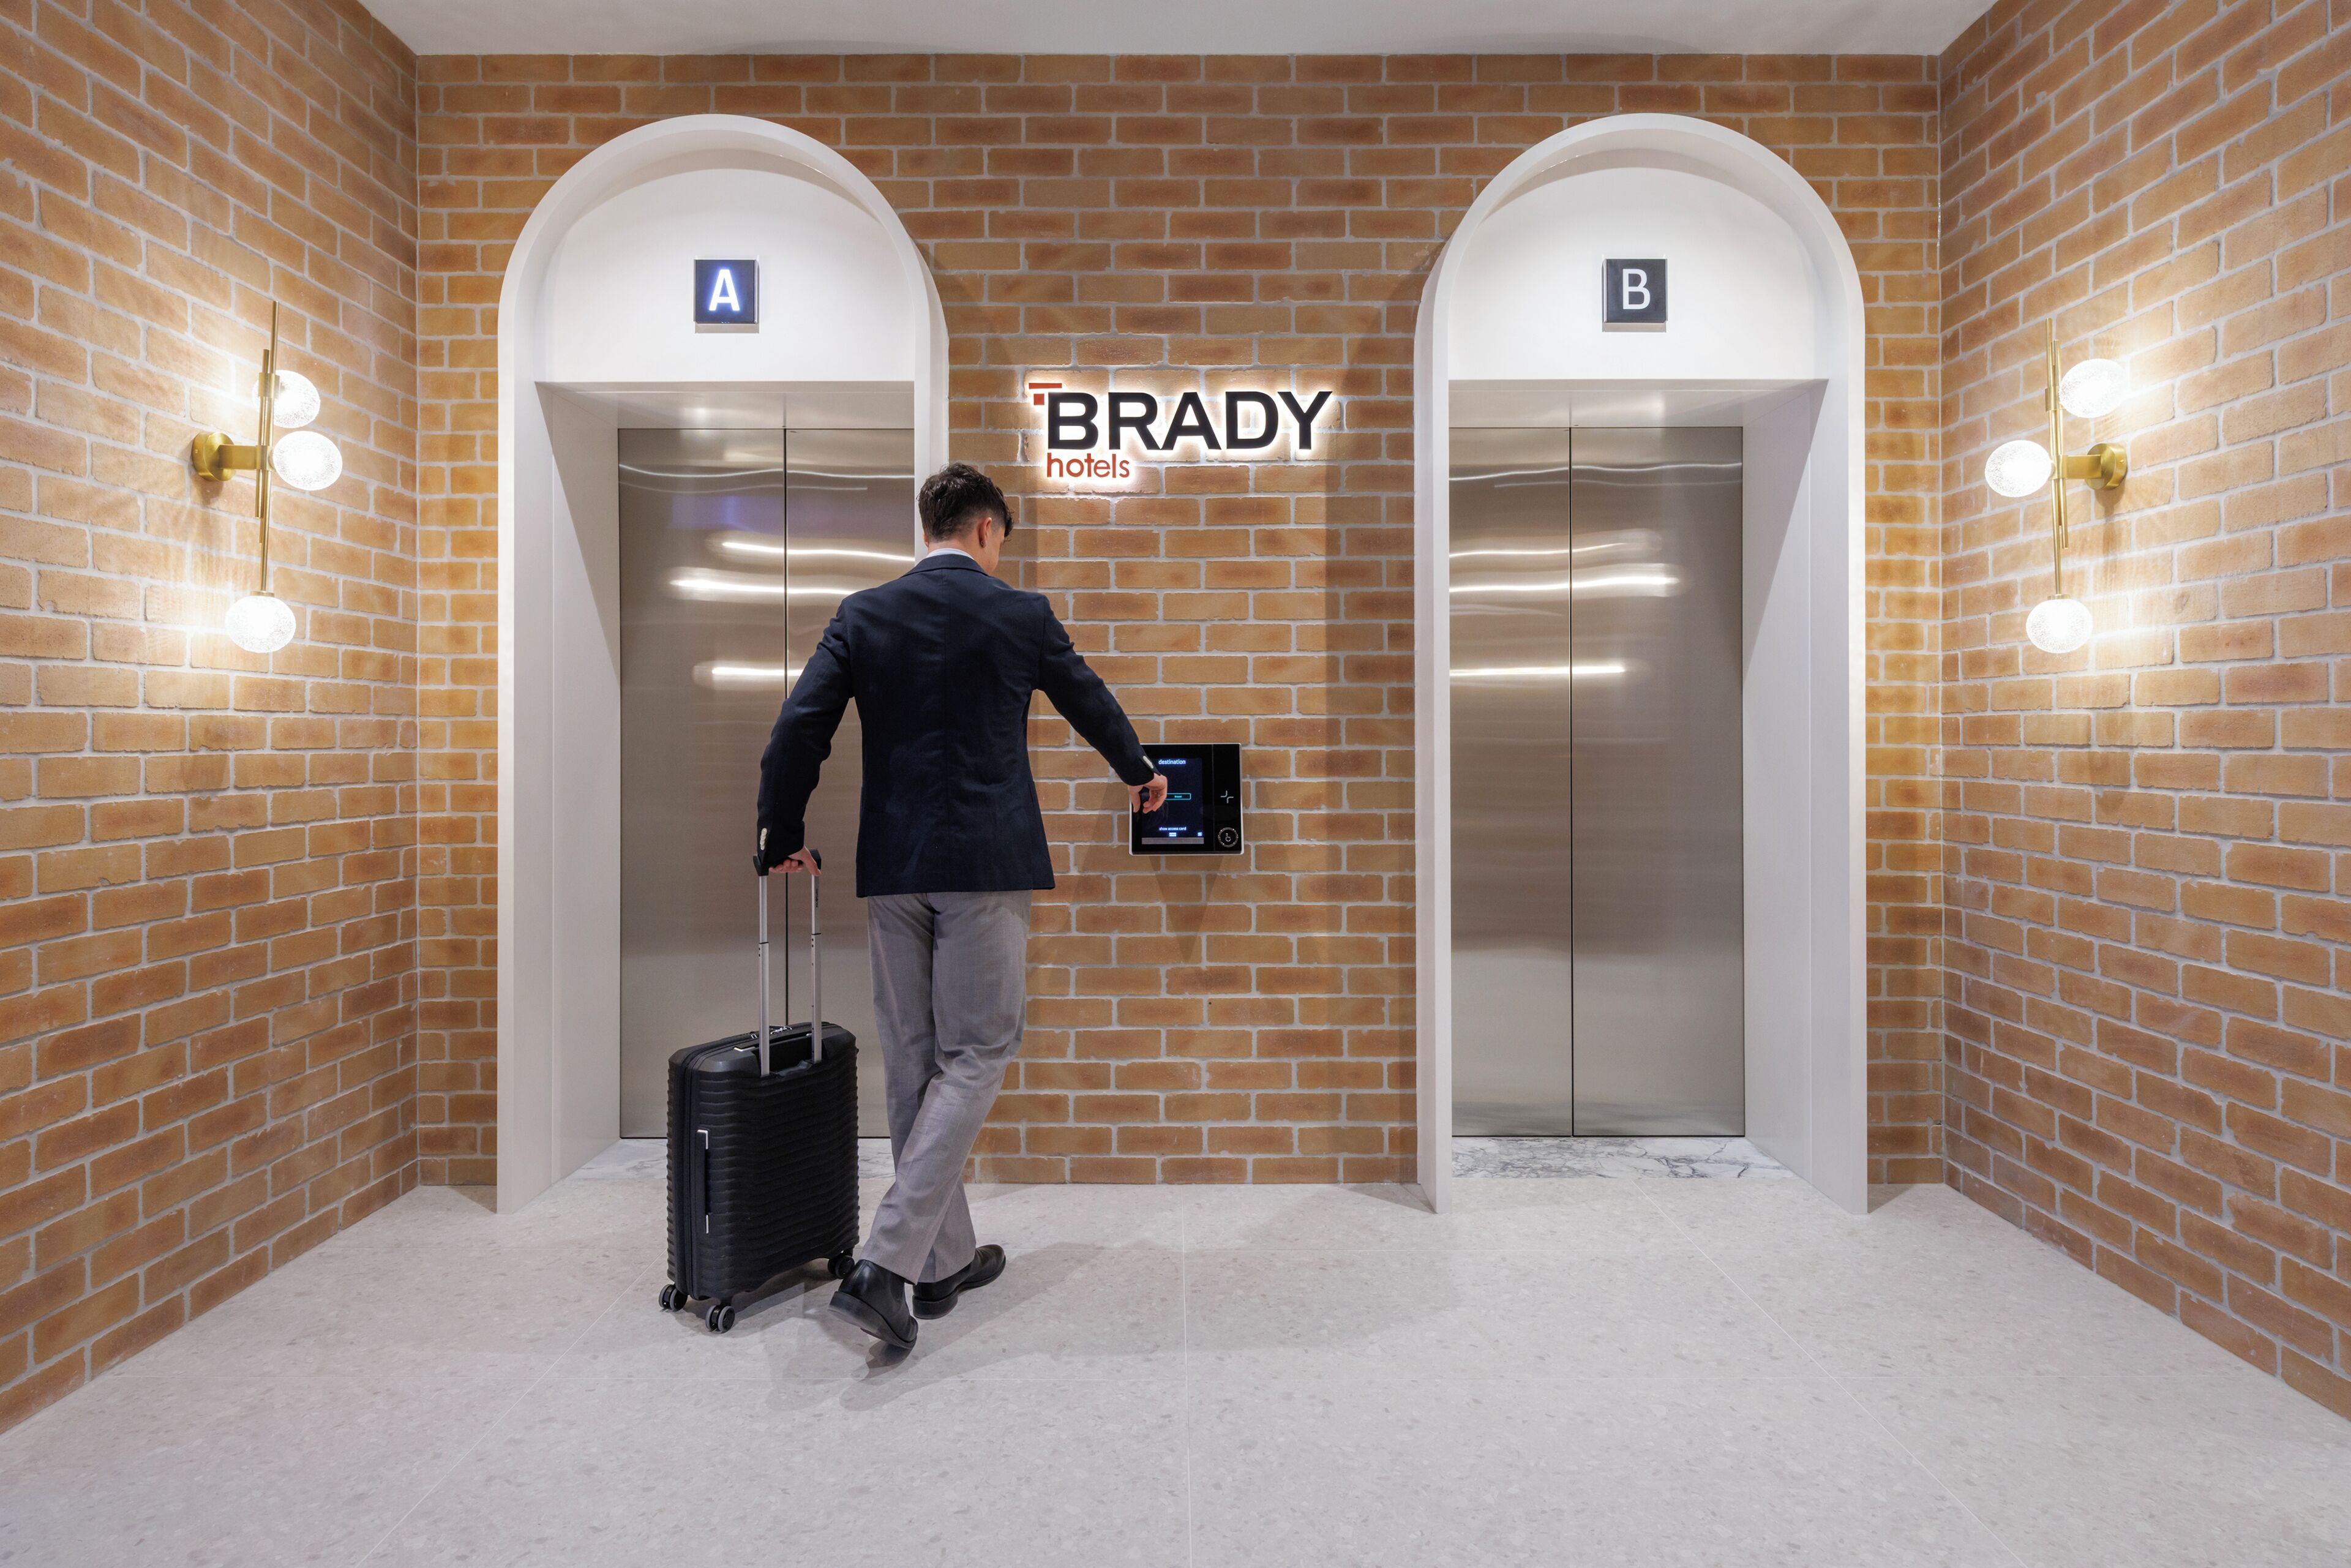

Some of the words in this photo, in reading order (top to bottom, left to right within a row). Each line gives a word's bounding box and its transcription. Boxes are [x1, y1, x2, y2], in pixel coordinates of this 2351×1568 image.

[708, 269, 740, 311] A
[1622, 268, 1651, 310] B
[1048, 391, 1333, 450] BRADY
[1046, 452, 1130, 478] hotels
